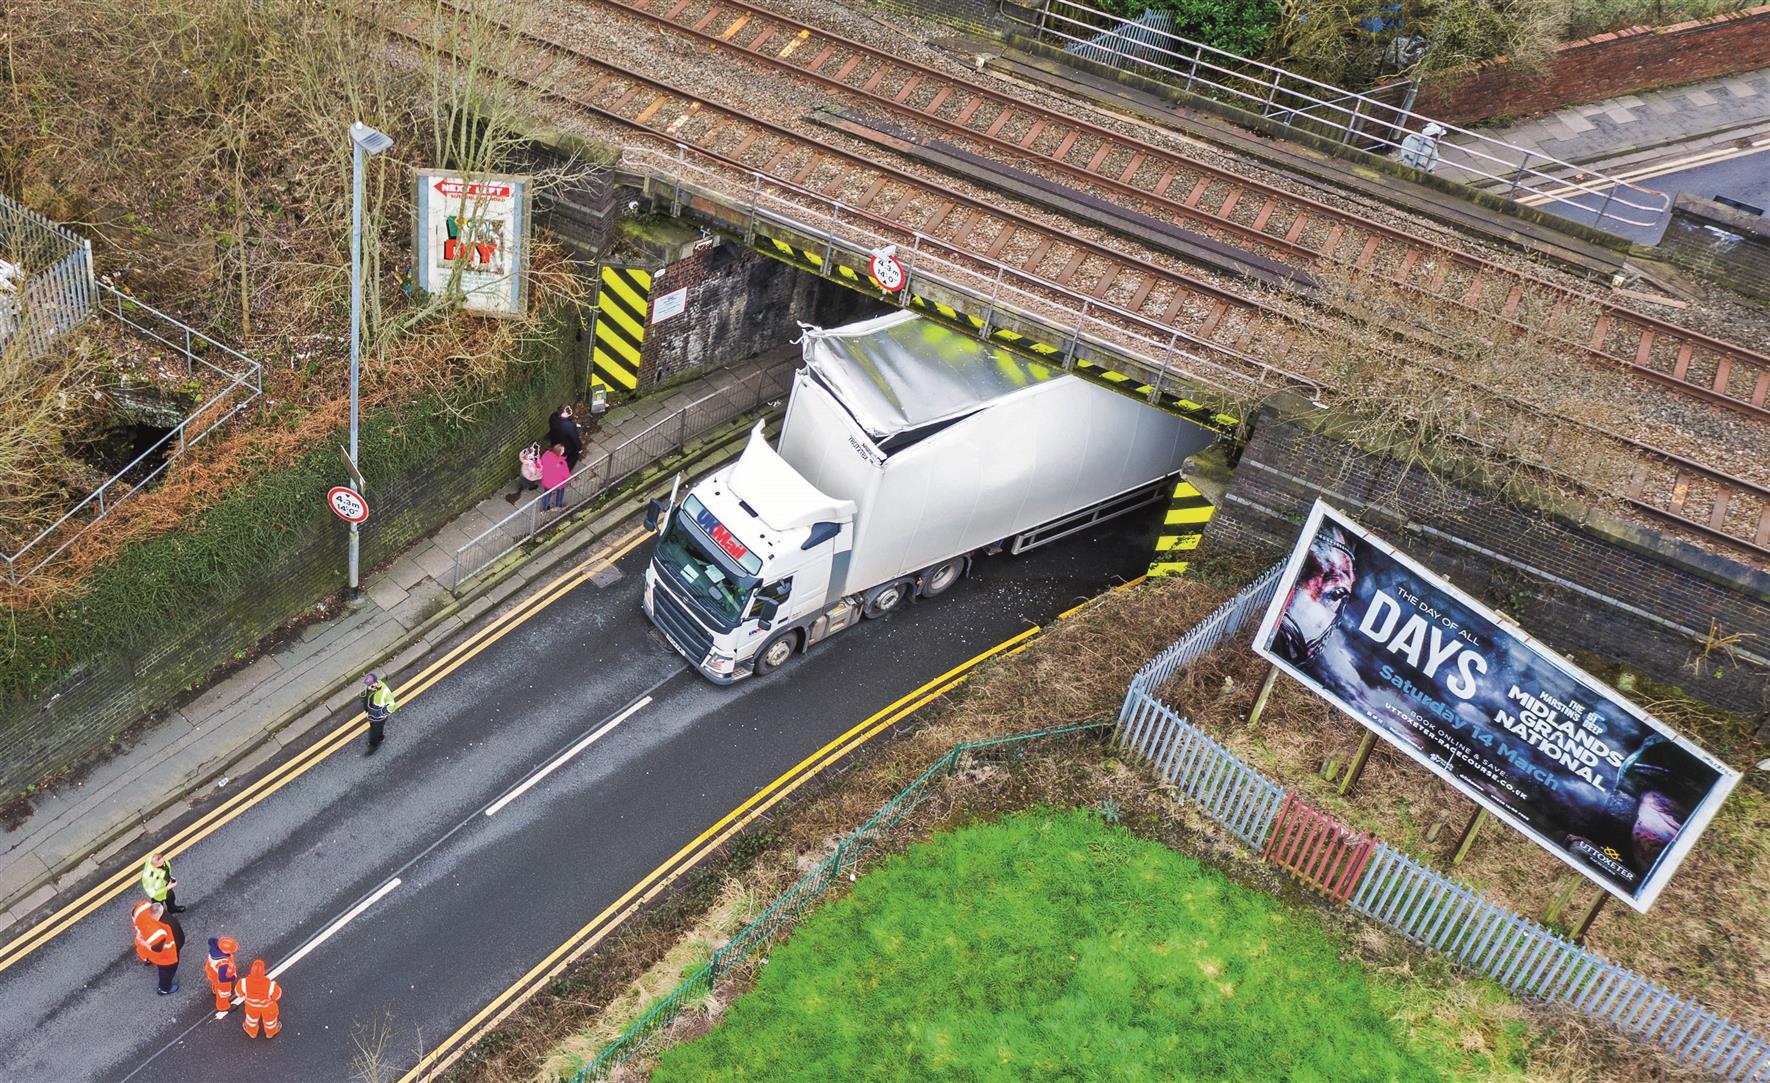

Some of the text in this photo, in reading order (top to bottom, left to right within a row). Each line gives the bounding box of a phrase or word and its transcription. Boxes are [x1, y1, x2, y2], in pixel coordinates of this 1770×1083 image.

[335, 495, 360, 509] 4.3m
[1358, 588, 1488, 700] DAYS
[1398, 587, 1480, 647] THE DAY OF ALL
[1379, 664, 1470, 730] Saturday
[1471, 722, 1494, 748] 14
[1497, 742, 1561, 791] March
[1410, 711, 1436, 731] BOOK
[1437, 729, 1472, 755] ONLINE
[1507, 684, 1625, 768] MIDLANDS
[1568, 700, 1587, 715] THE
[1384, 702, 1528, 801] UTTOXETER-RACECOURSE.CO.UK
[1494, 709, 1606, 792] NATIONAL
[1519, 710, 1599, 768] GRAND
[1579, 841, 1635, 881] UTTOXETER
